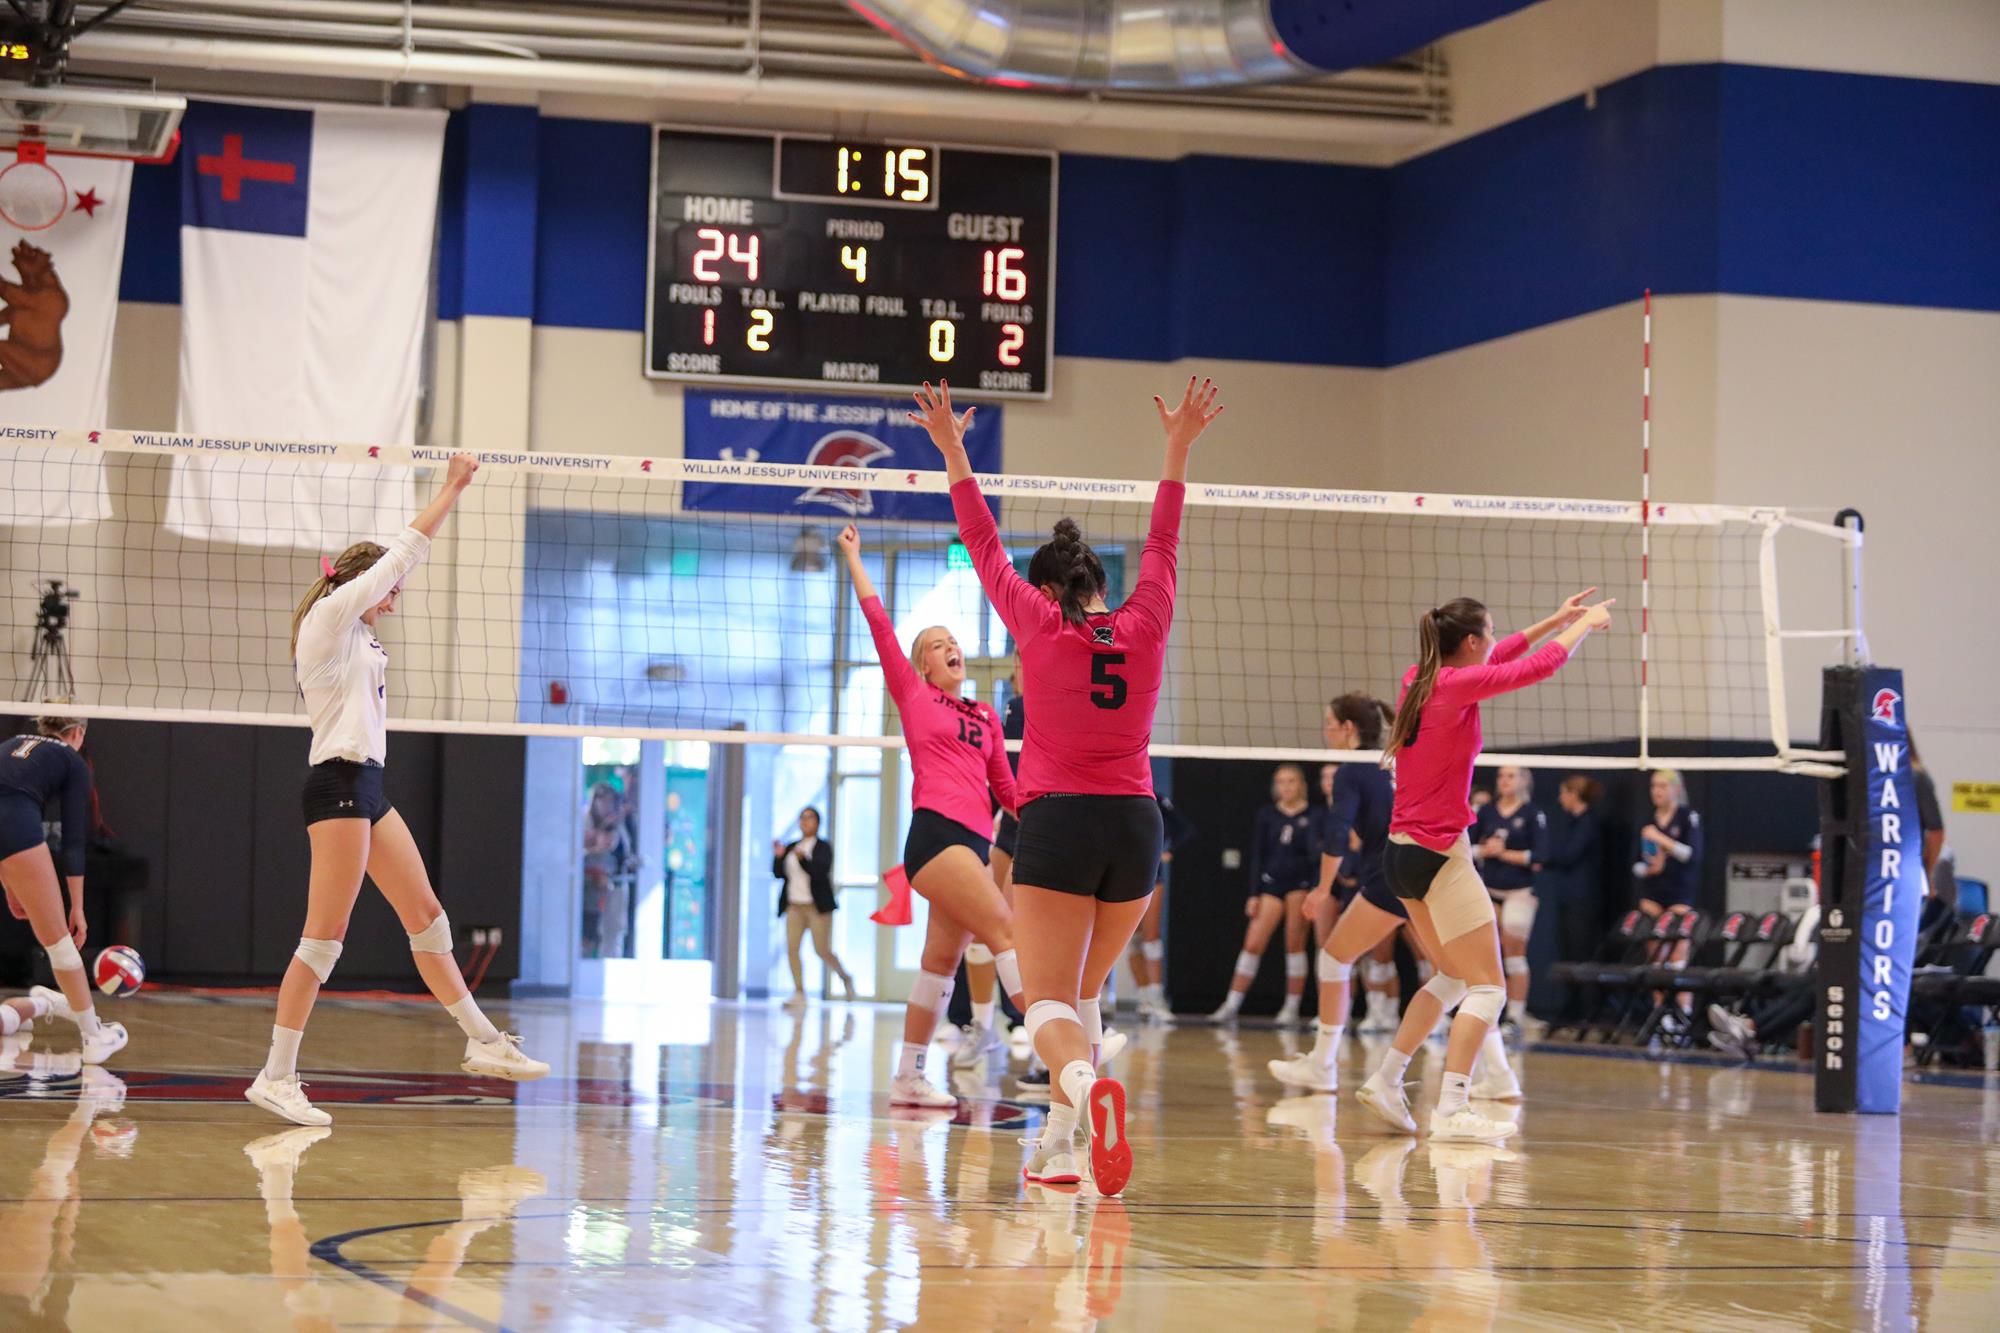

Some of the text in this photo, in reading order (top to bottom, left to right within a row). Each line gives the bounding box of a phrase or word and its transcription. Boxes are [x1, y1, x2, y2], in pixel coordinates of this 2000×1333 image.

[837, 147, 928, 201] 1:15
[683, 195, 753, 224] HOME
[826, 219, 884, 240] PERIOD
[948, 212, 1023, 243] GUEST
[693, 228, 759, 281] 24
[841, 245, 867, 283] 4
[983, 248, 1026, 300] 16
[669, 284, 722, 305] FOULS
[799, 292, 907, 317] PLAYER FOUL
[703, 308, 715, 345] 1
[981, 303, 1033, 324] FOULS
[747, 309, 774, 351] 2
[929, 320, 955, 362] 0
[998, 323, 1024, 365] 2
[667, 353, 721, 374] SCORE
[822, 361, 879, 381] MATCH
[979, 370, 1032, 390] SCORE
[710, 398, 760, 419] HOME
[761, 400, 785, 420] OF
[787, 402, 819, 422] THE
[820, 404, 885, 425] JESSUP
[132, 434, 338, 455] WILLIAM JESSUP UNIVERSITY
[530, 456, 612, 470] UNIVERSITY
[683, 463, 878, 482] WILLIAM JESSUP UNIVERSITY
[1007, 478, 1057, 491] JESSUP
[1060, 481, 1136, 494] UNIVERSITY
[1204, 487, 1388, 505] WILLIAM JESSUP UNIVERSITY
[1452, 498, 1631, 514] WILLIAM JESSUP UNIVERSITY
[1090, 653, 1128, 710] 5
[958, 718, 983, 750] 12
[1872, 743, 1902, 1021] WARRIORS
